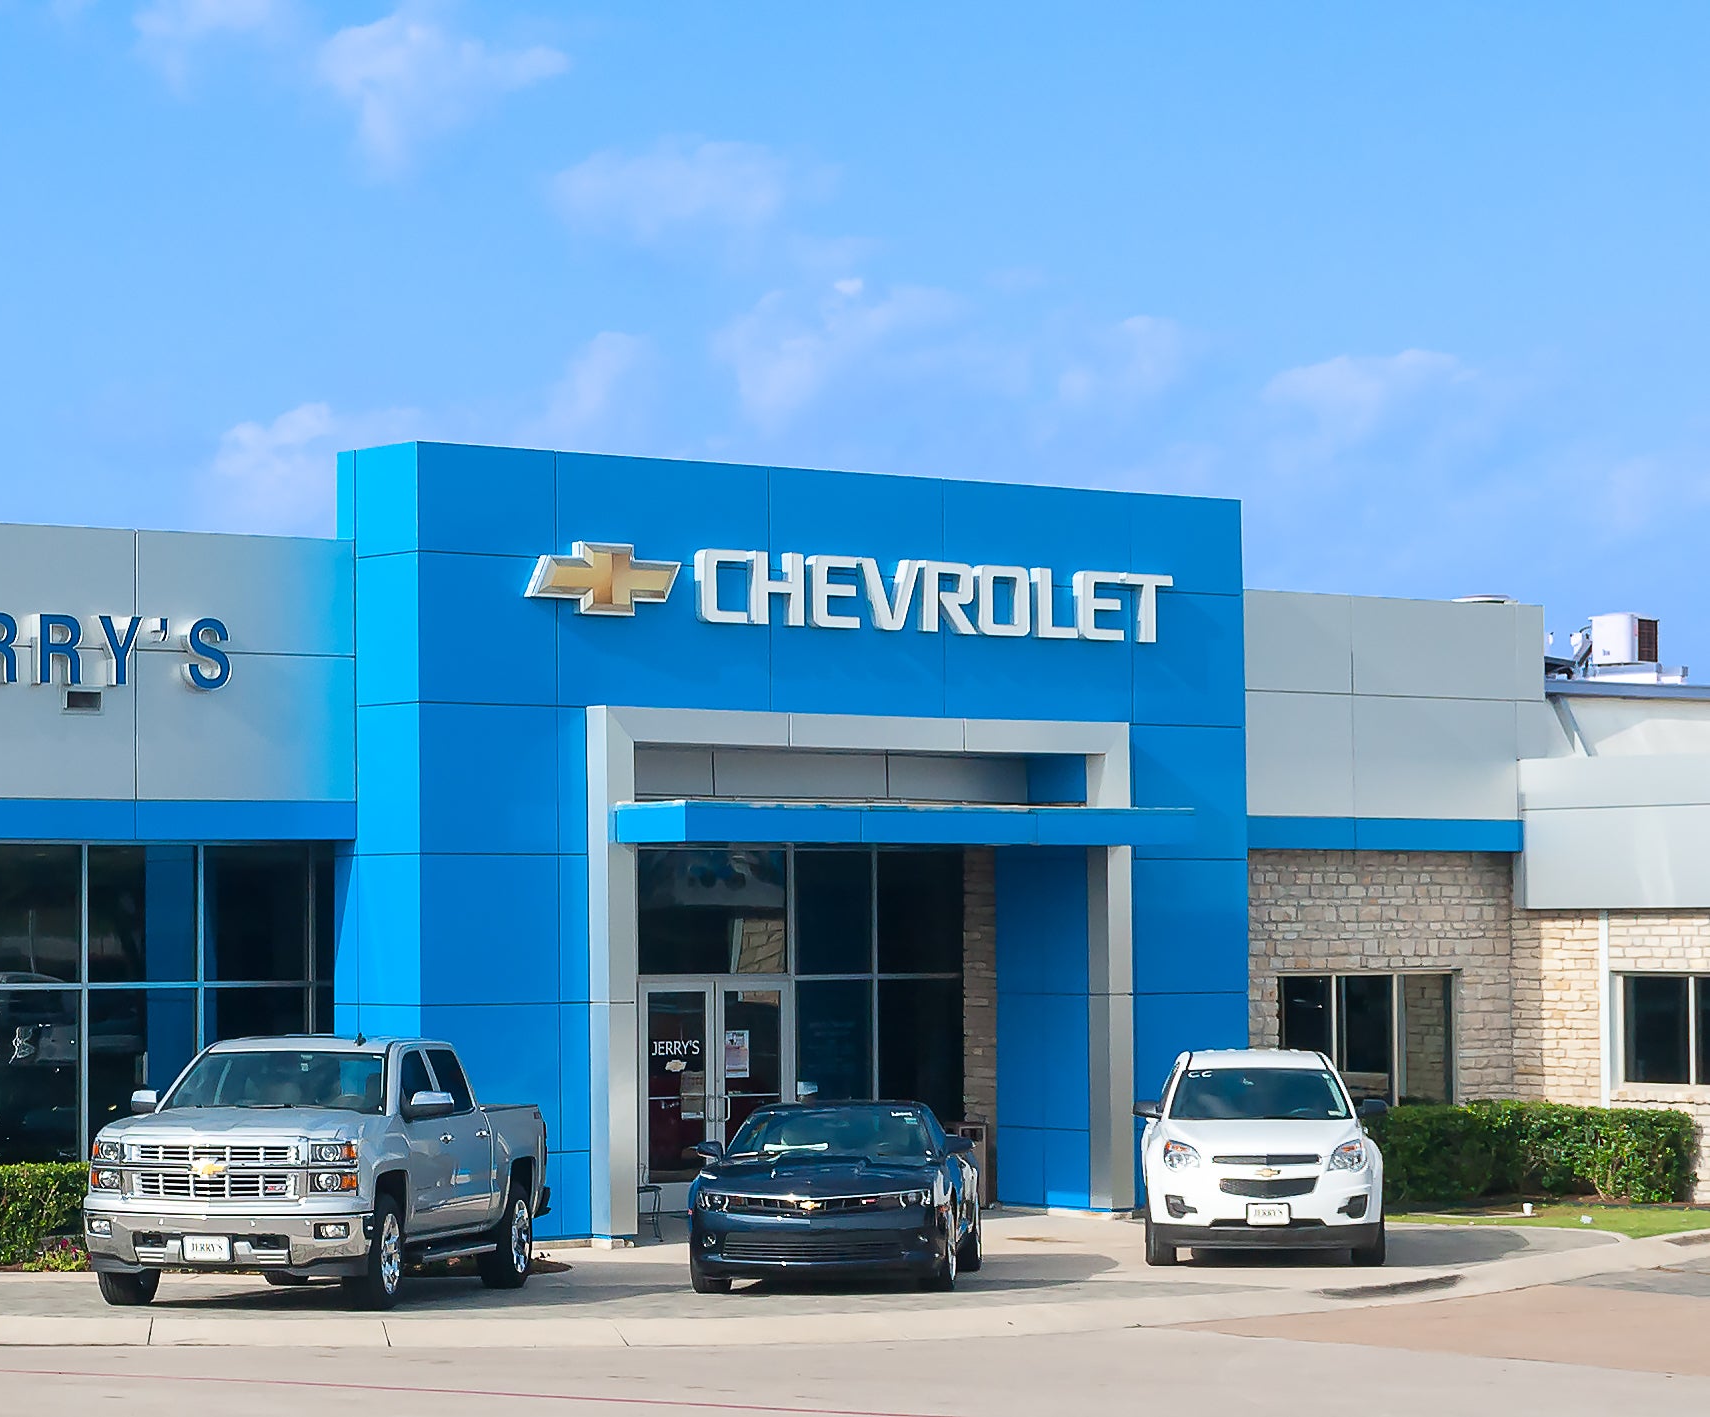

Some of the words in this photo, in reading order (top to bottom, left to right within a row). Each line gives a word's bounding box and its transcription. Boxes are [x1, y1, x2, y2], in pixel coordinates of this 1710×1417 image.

[694, 548, 1174, 643] CHEVROLET
[651, 1040, 700, 1057] JERRY'S
[191, 1242, 223, 1252] JERRY'S
